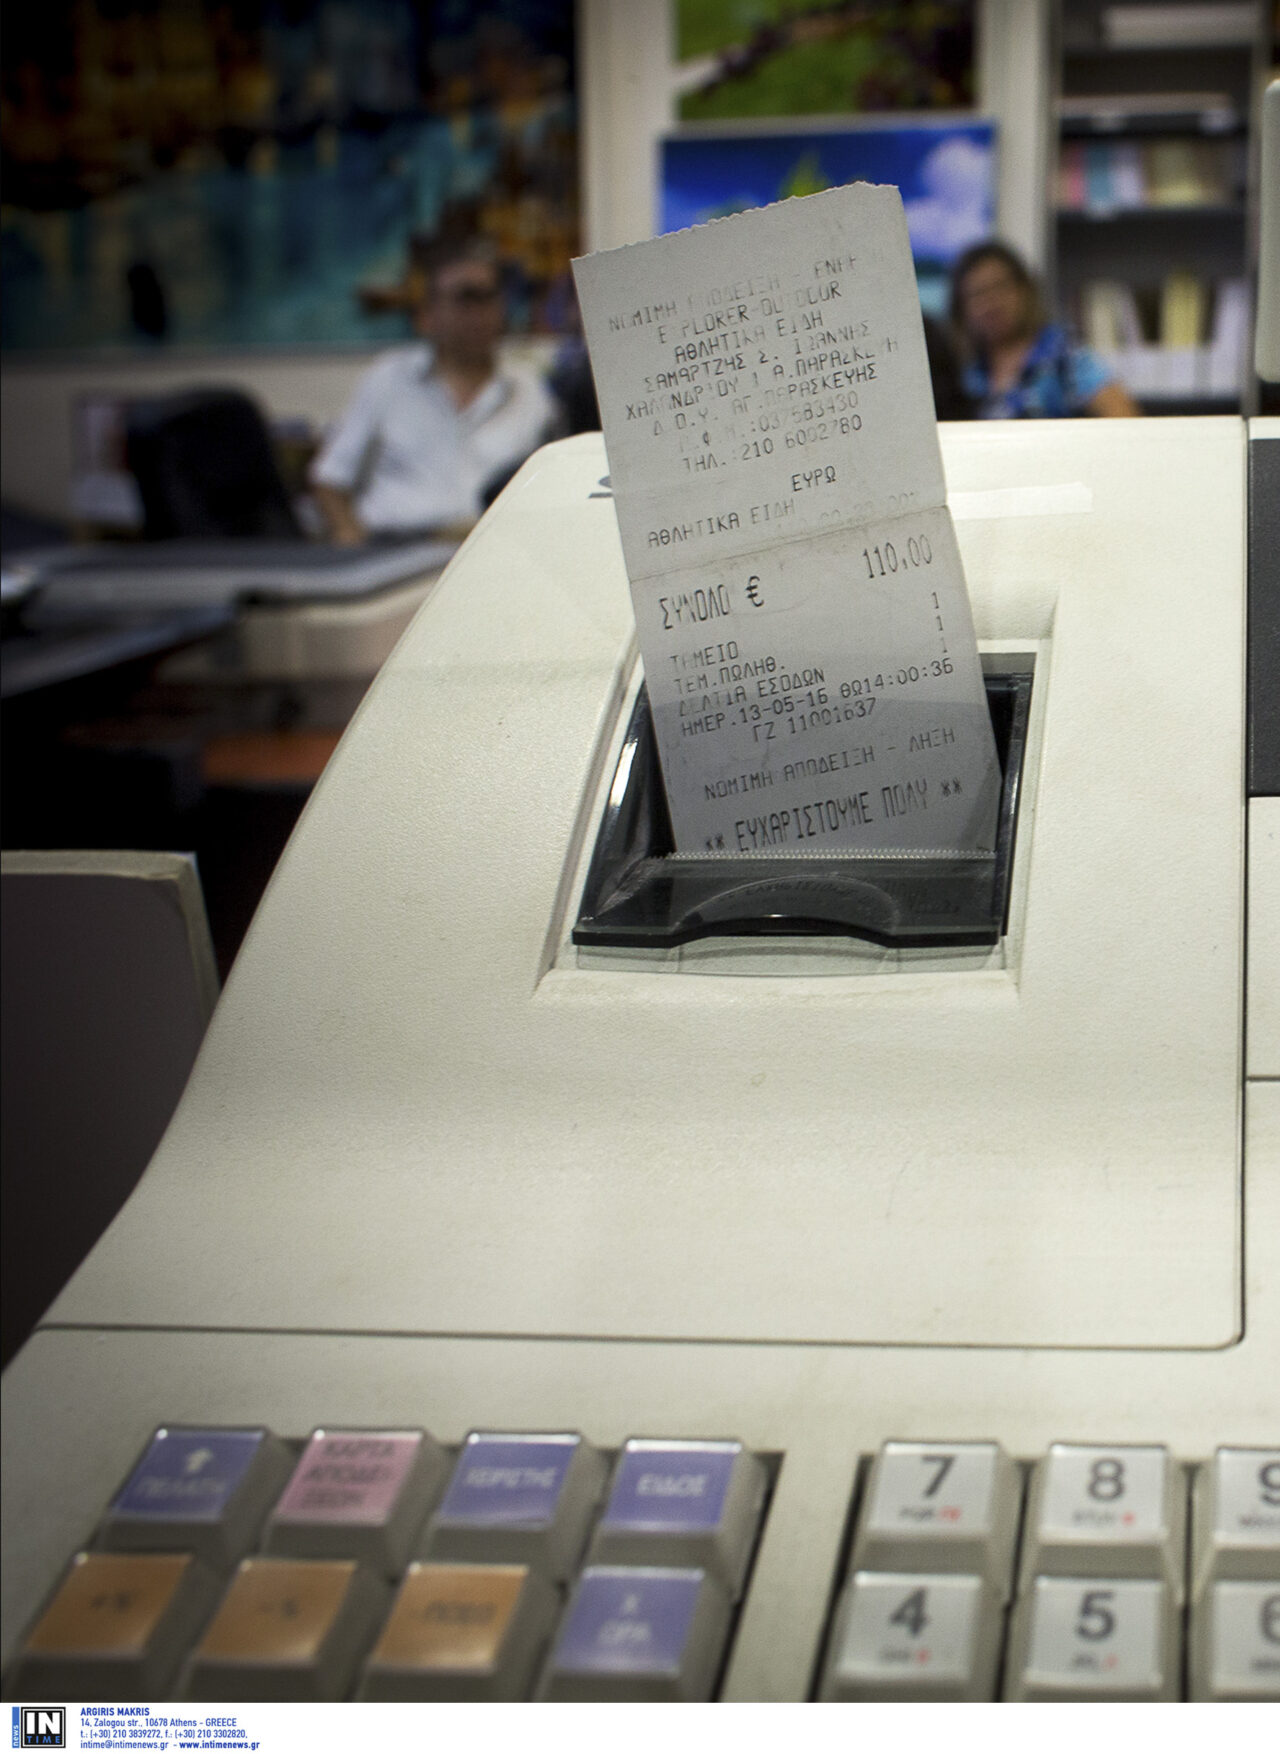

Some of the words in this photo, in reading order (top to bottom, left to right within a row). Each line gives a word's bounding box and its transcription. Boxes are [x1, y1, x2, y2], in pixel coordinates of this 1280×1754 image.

[674, 325, 765, 364] ΑΘΛΗΤΙΚΑ
[776, 310, 823, 337] ΕΙΔΗ
[791, 465, 836, 492] ΕΥΡΩ
[648, 512, 740, 548] ΑΘΛΗΤΙΚΑ
[750, 498, 796, 526] ΕΙΔΗ
[659, 584, 730, 630] ΣΥΝΟΛΟ
[745, 575, 764, 608] €
[862, 534, 933, 579] 110,00
[931, 592, 939, 609] 1
[936, 615, 943, 631] 1
[757, 668, 825, 698] ΕΣΟΔΩΝ
[704, 771, 774, 800] ΝΟΜΙΜΗ
[783, 746, 875, 781] ΑΠΟΔΕΙΞΗ
[910, 728, 955, 753] ΛΗΞΗ
[735, 791, 873, 852] ΕΥΧΑΡΙΣΤΟΥΜΕ
[881, 778, 928, 818] ΠΟΛΥ
[920, 1455, 956, 1498] 7
[1086, 1457, 1127, 1503] 8
[888, 1586, 930, 1639] 4
[1076, 1590, 1116, 1643] 5
